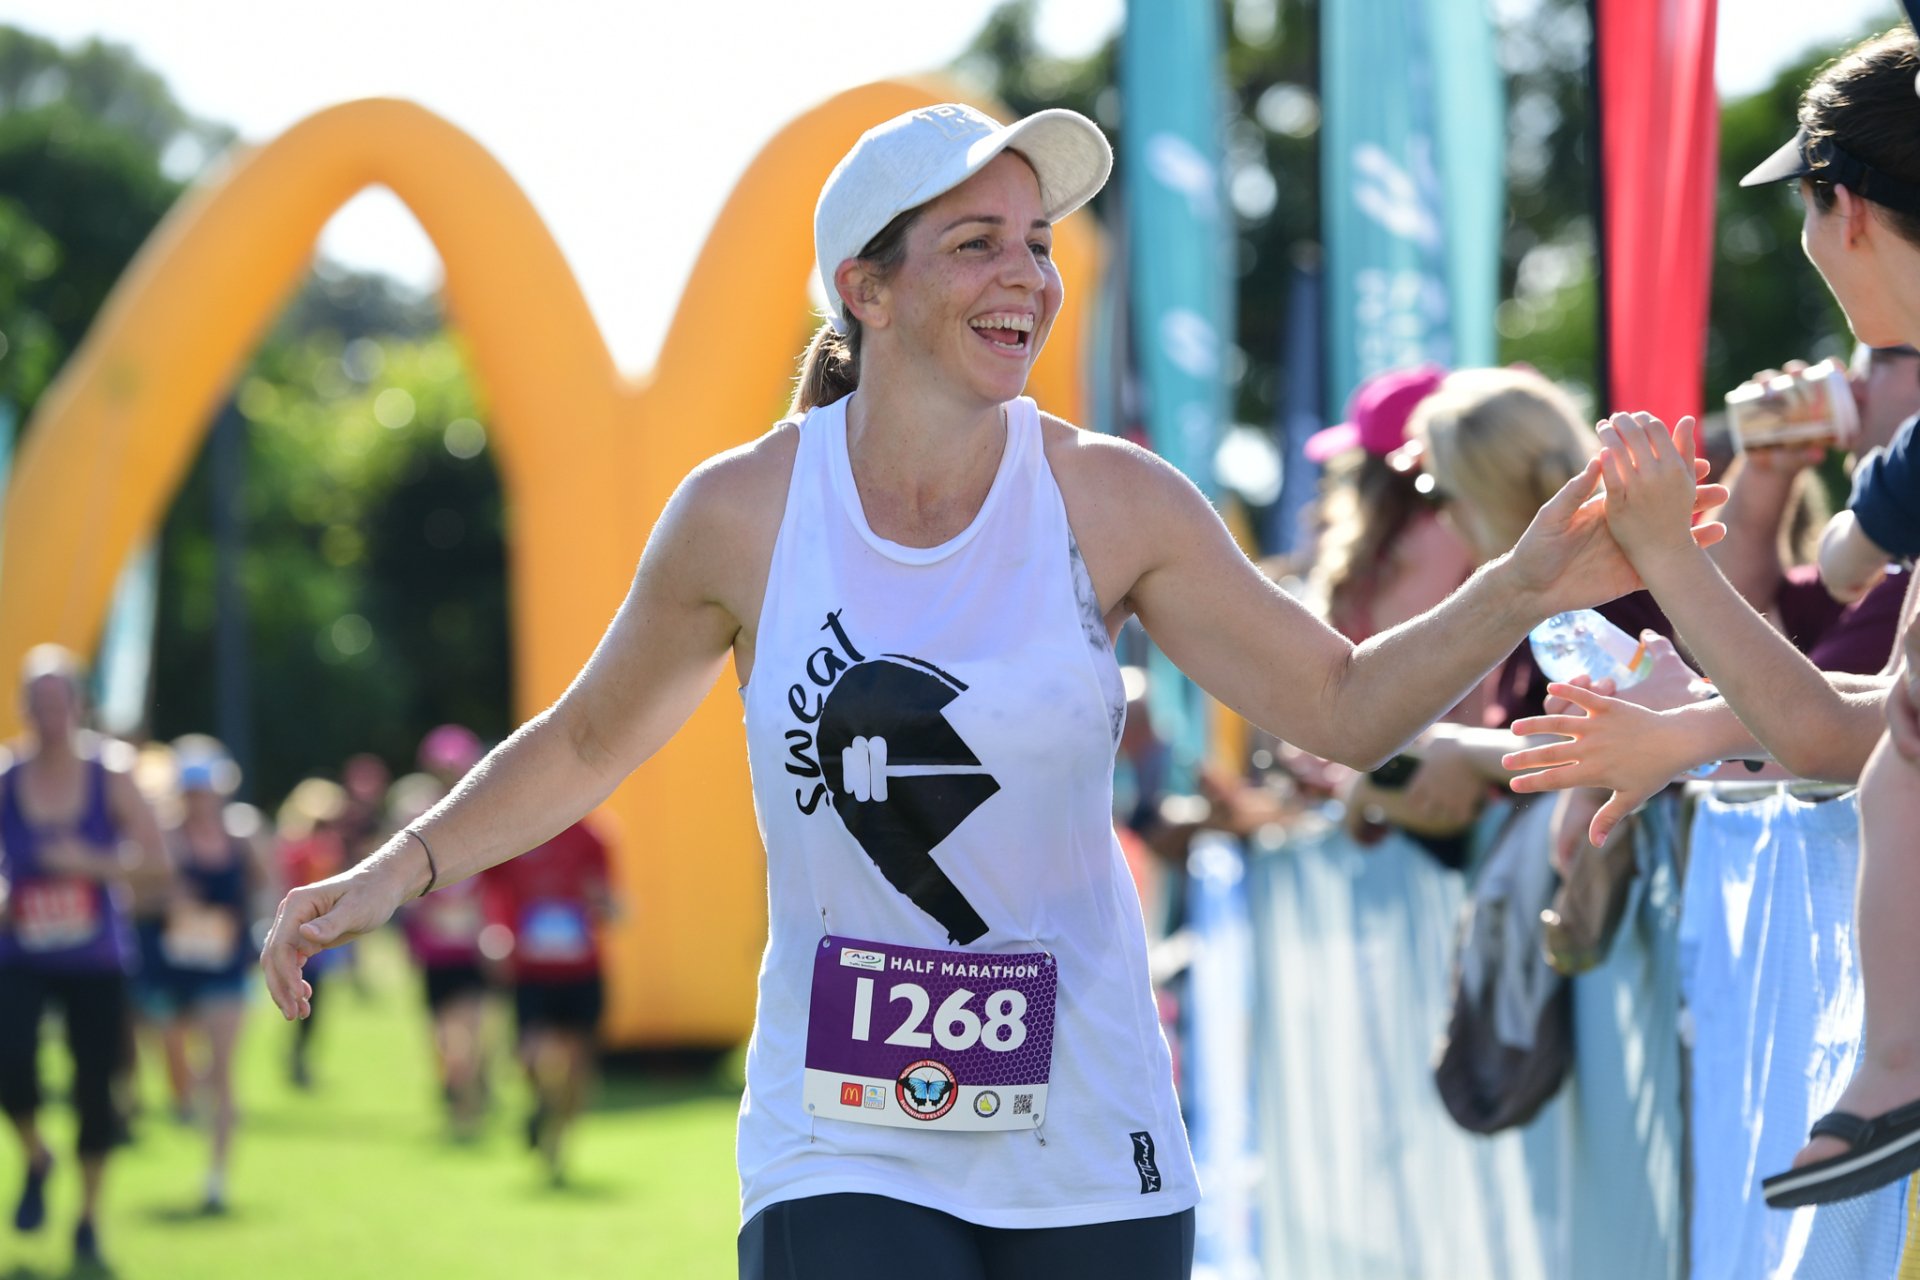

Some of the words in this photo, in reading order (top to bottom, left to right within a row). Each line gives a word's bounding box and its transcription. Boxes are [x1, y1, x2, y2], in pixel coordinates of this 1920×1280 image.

[785, 608, 866, 815] sweat
[891, 957, 934, 974] HALF
[942, 963, 1038, 978] MARATHON
[852, 977, 1027, 1051] 1268
[900, 1100, 926, 1118] RUNNING
